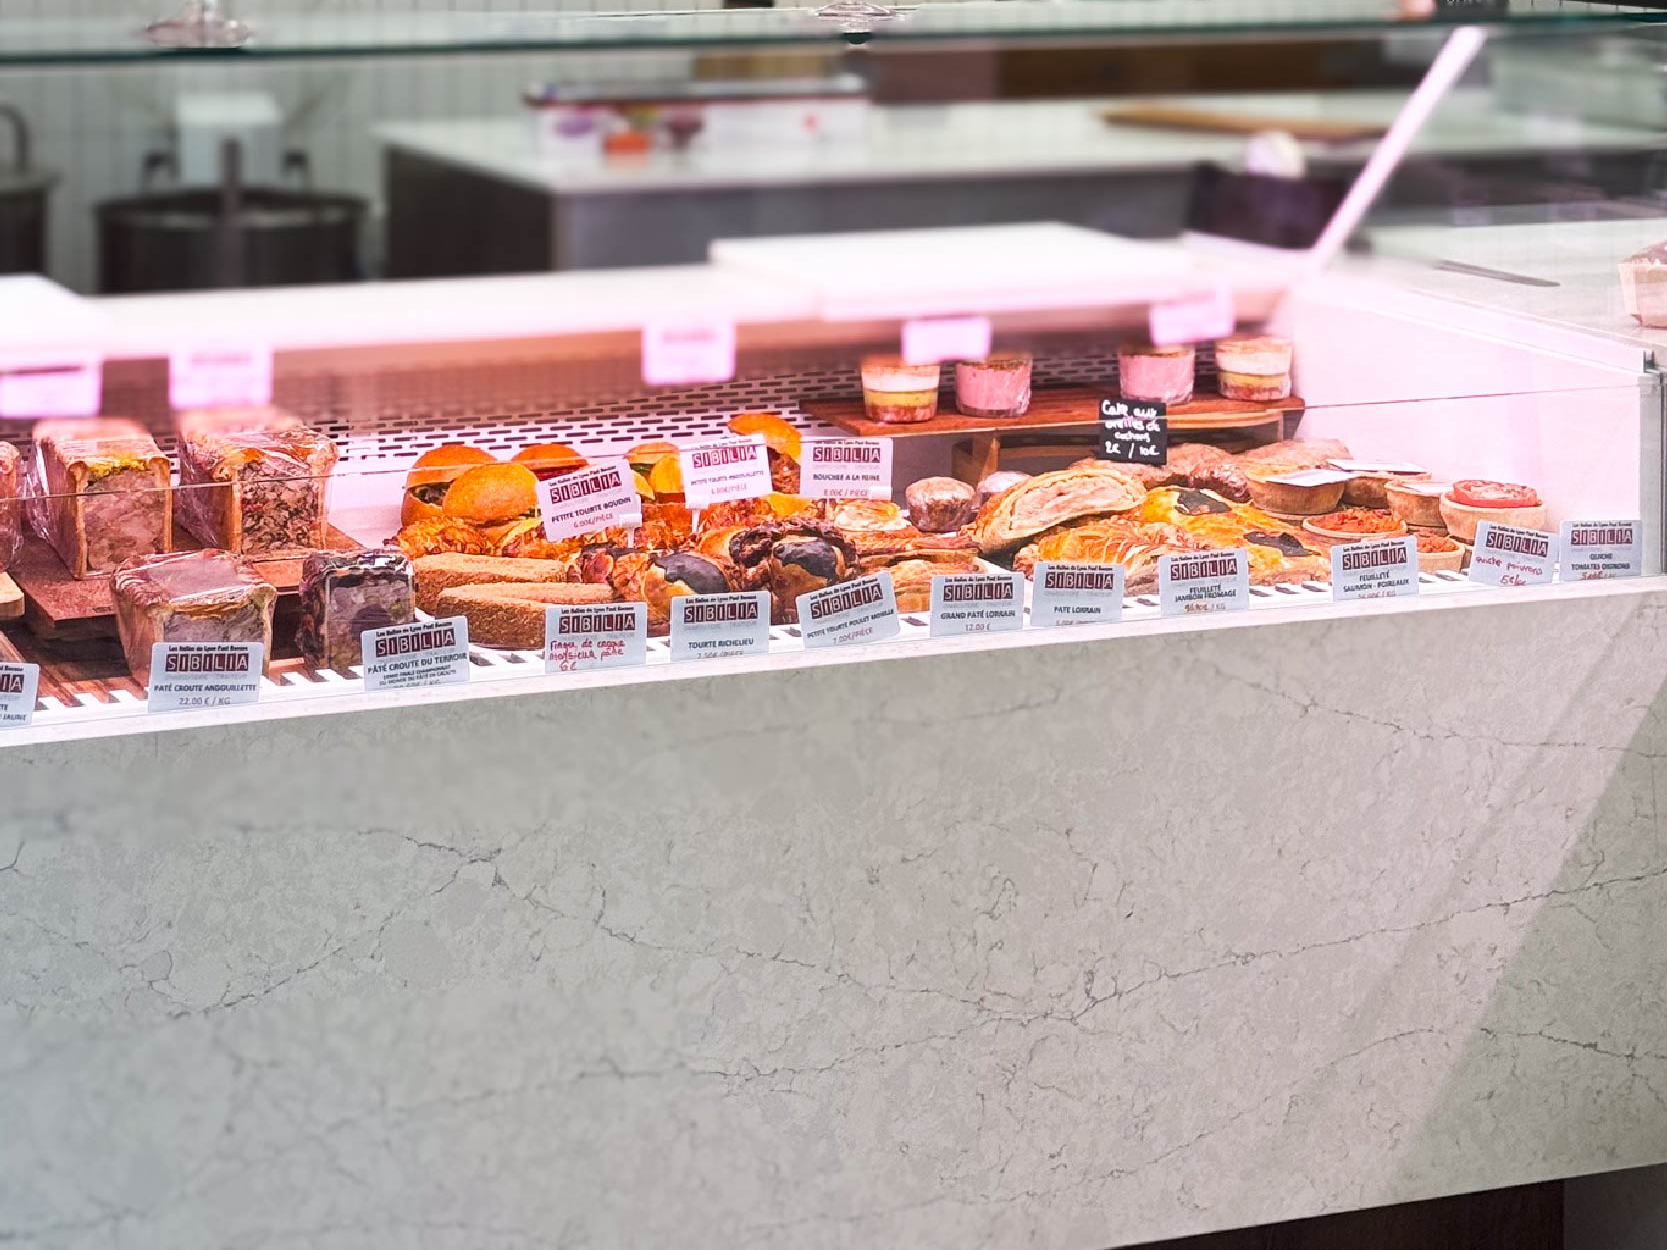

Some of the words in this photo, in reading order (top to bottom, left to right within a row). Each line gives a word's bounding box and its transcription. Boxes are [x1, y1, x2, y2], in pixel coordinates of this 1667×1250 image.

[692, 445, 757, 469] SIBILIA
[813, 447, 880, 463] SIBILIA
[550, 471, 622, 504] SIBILIA
[1486, 531, 1549, 558] SIBILIA
[1571, 528, 1633, 546] SIBILIA
[1343, 547, 1406, 570] SIBILIA
[1171, 558, 1237, 581] SIBILIA
[1045, 572, 1113, 589] SIBILIA
[811, 583, 883, 619] SIBILIA
[943, 582, 1013, 602] SIBILIA
[684, 602, 757, 622] SIBILIA
[559, 613, 635, 633] SIBILIA
[376, 629, 456, 657] SIBILIA
[165, 653, 249, 672] SIBILIA
